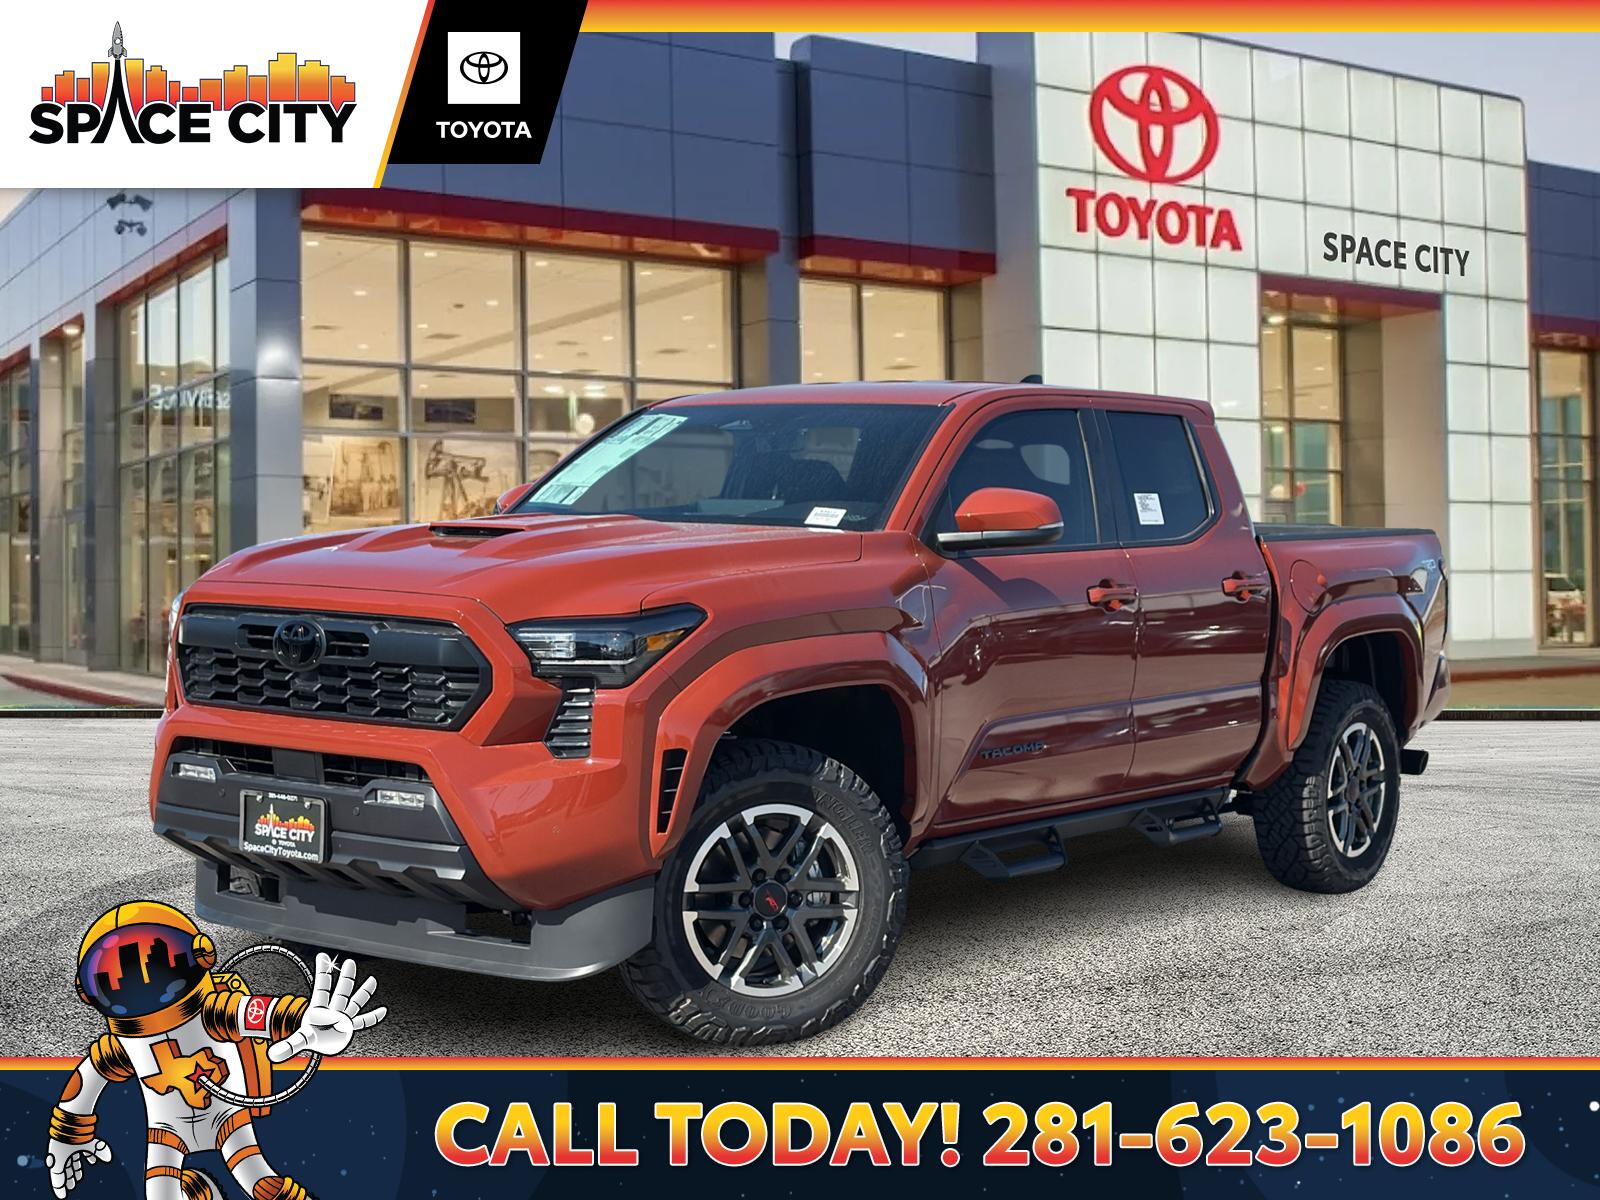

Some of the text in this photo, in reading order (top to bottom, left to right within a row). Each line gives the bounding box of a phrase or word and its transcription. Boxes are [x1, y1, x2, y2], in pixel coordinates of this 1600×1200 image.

[1066, 187, 1242, 252] TOYOTA
[1323, 232, 1470, 277] SPACE CITY
[981, 741, 1047, 760] TACOMA
[254, 822, 315, 843] SPACE CITY
[243, 841, 319, 861] SpaceCityToyota.com
